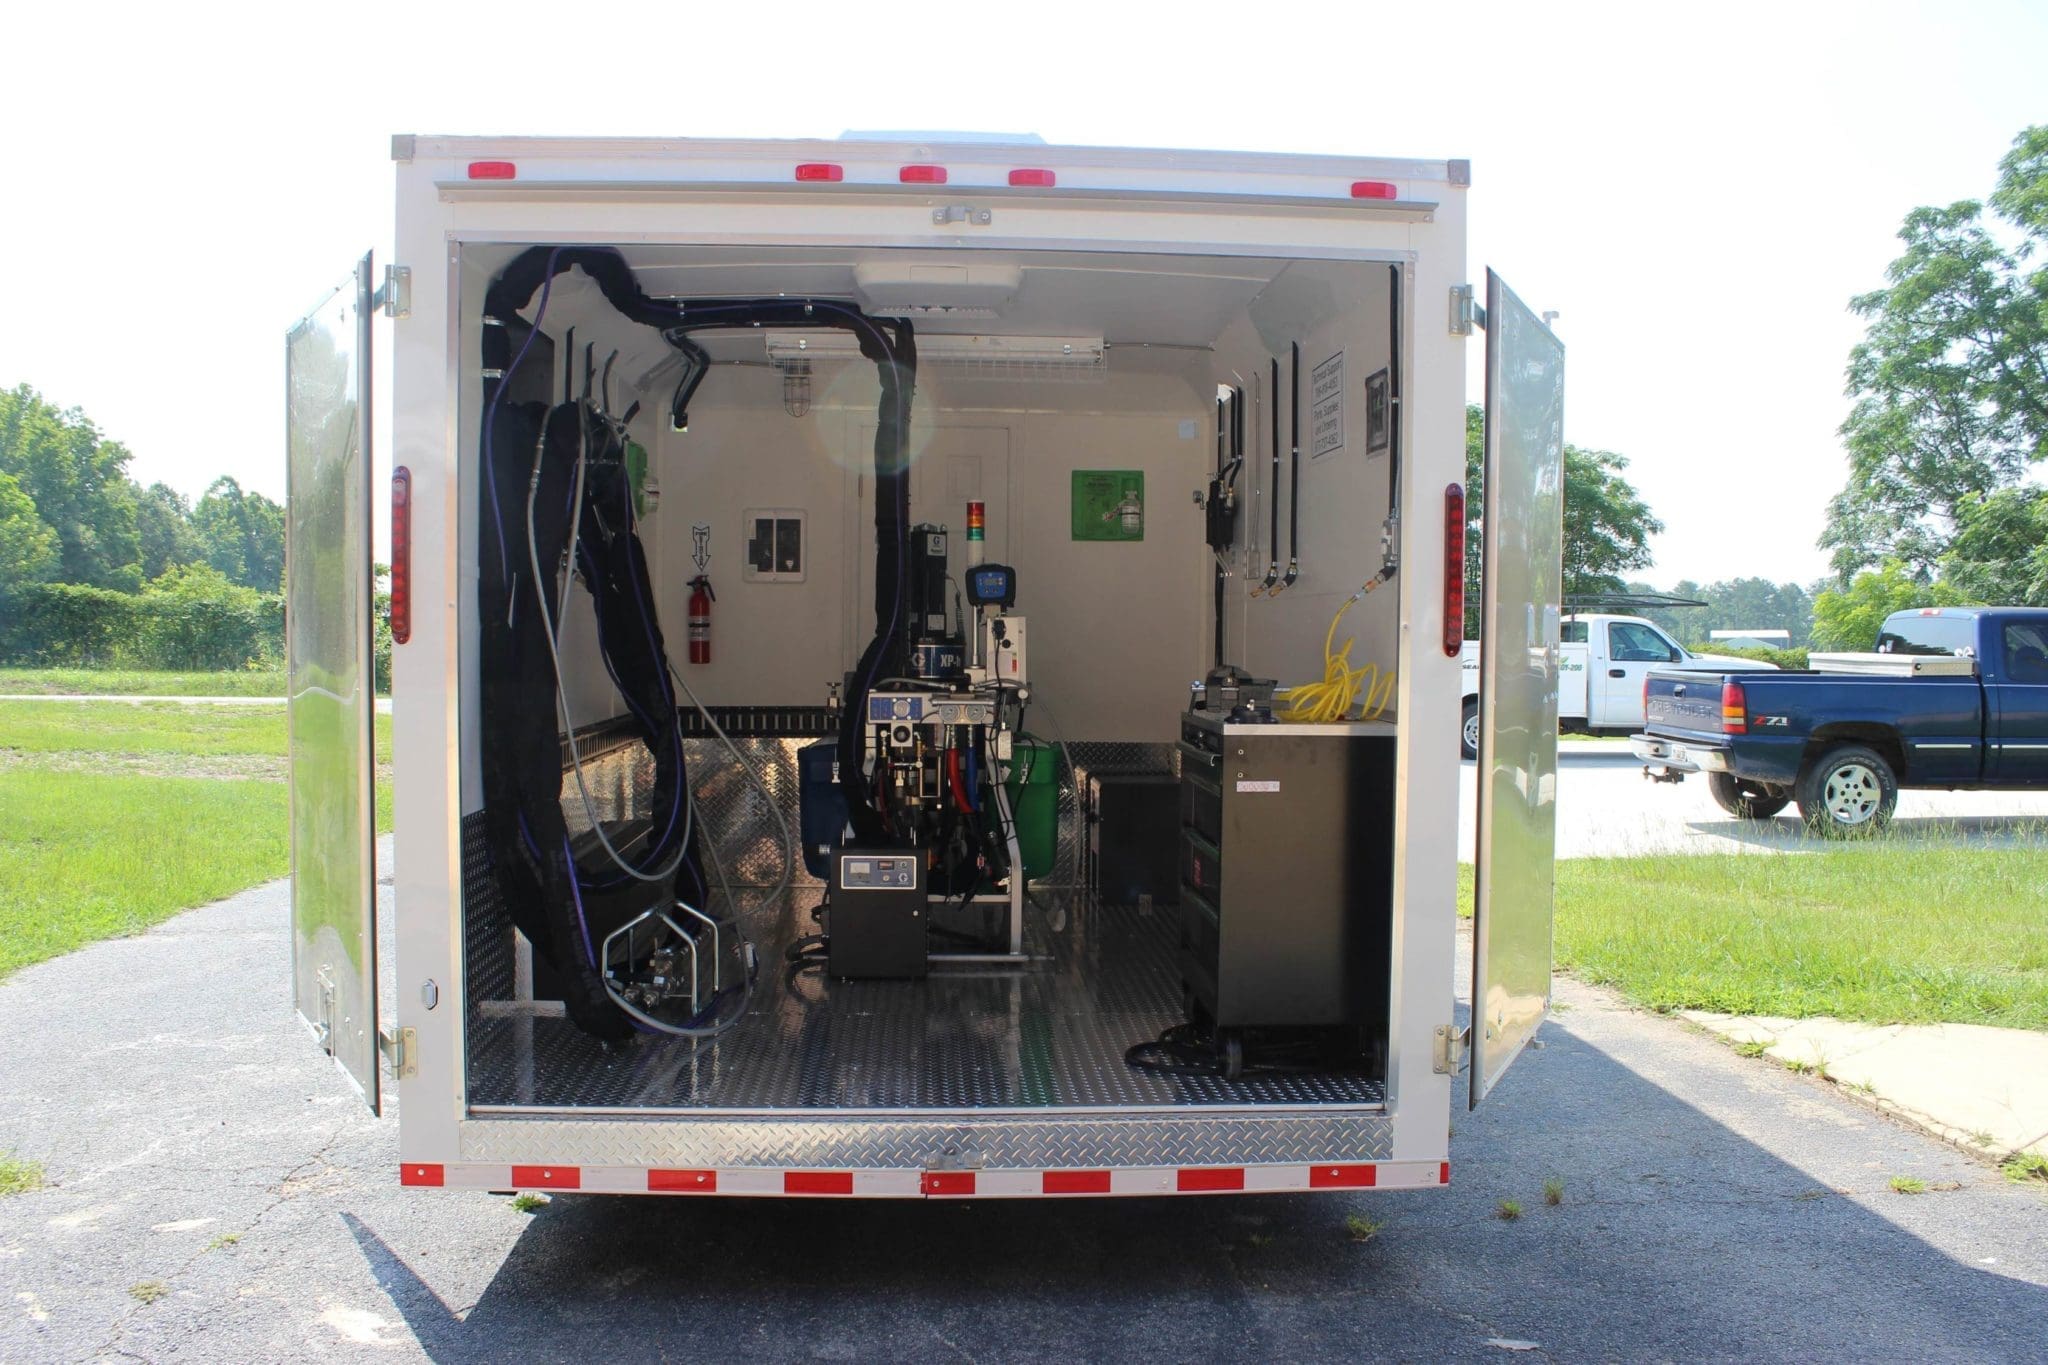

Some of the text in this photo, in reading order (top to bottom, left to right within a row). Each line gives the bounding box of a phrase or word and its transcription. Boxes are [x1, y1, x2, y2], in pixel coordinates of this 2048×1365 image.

[1328, 360, 1342, 376] Support
[1651, 698, 1714, 720] CHEVROLET
[1753, 715, 1789, 726] Z71
